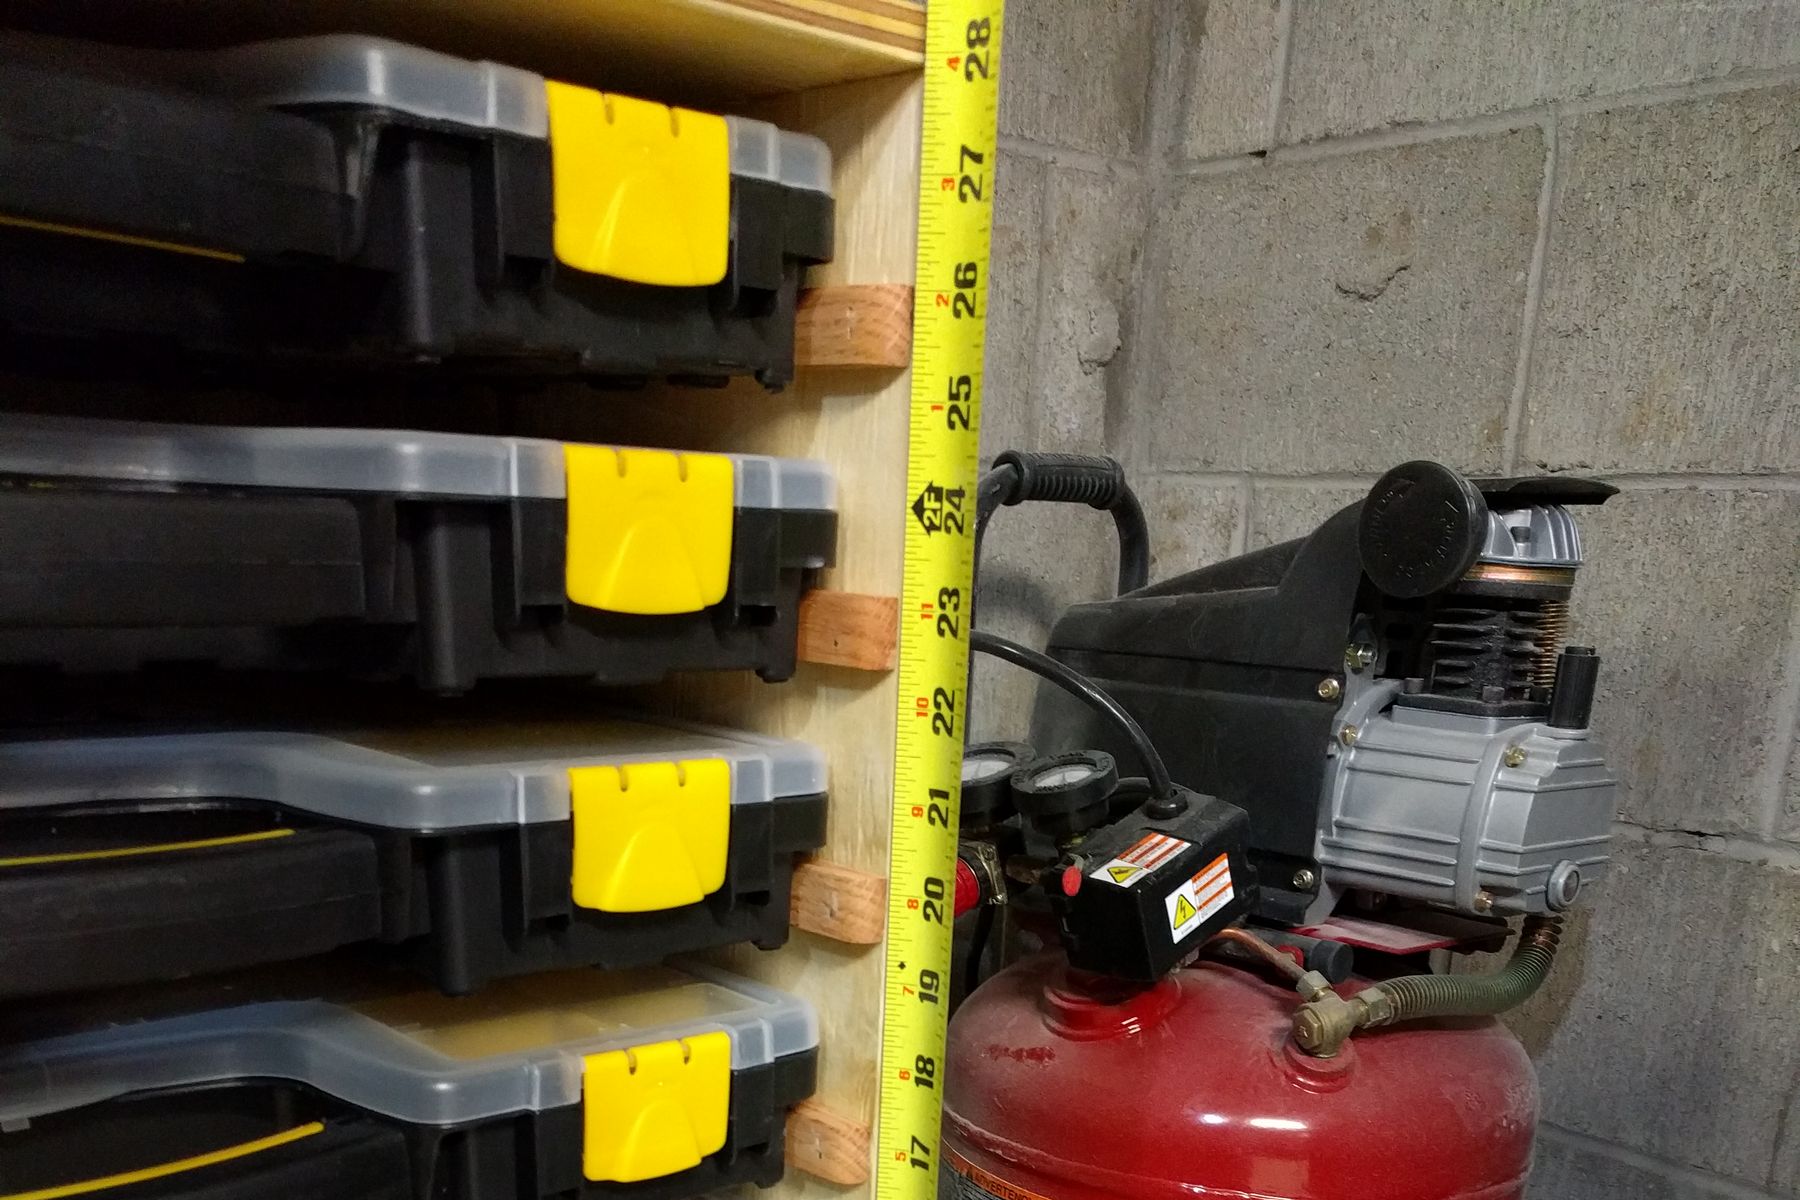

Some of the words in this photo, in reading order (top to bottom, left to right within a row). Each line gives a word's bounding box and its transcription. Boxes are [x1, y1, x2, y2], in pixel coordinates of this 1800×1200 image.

[946, 57, 960, 72] 4
[965, 17, 991, 82] 28
[941, 177, 955, 191] 3
[958, 144, 984, 203] 27
[935, 293, 950, 307] 2
[953, 261, 977, 319] 26
[947, 375, 972, 432] 25
[944, 485, 966, 536] 24
[920, 603, 933, 620] 11
[937, 587, 960, 640] 23
[916, 697, 929, 717] 10
[932, 687, 955, 738] 22
[911, 806, 924, 818] 9
[928, 788, 950, 829] 21
[907, 898, 919, 910] 8
[923, 876, 944, 926] 20
[903, 986, 915, 996] 7
[919, 969, 940, 1005] 19
[899, 1070, 911, 1081] 6
[915, 1054, 935, 1090] 18
[895, 1152, 907, 1162] 5
[910, 1135, 930, 1172] 17
